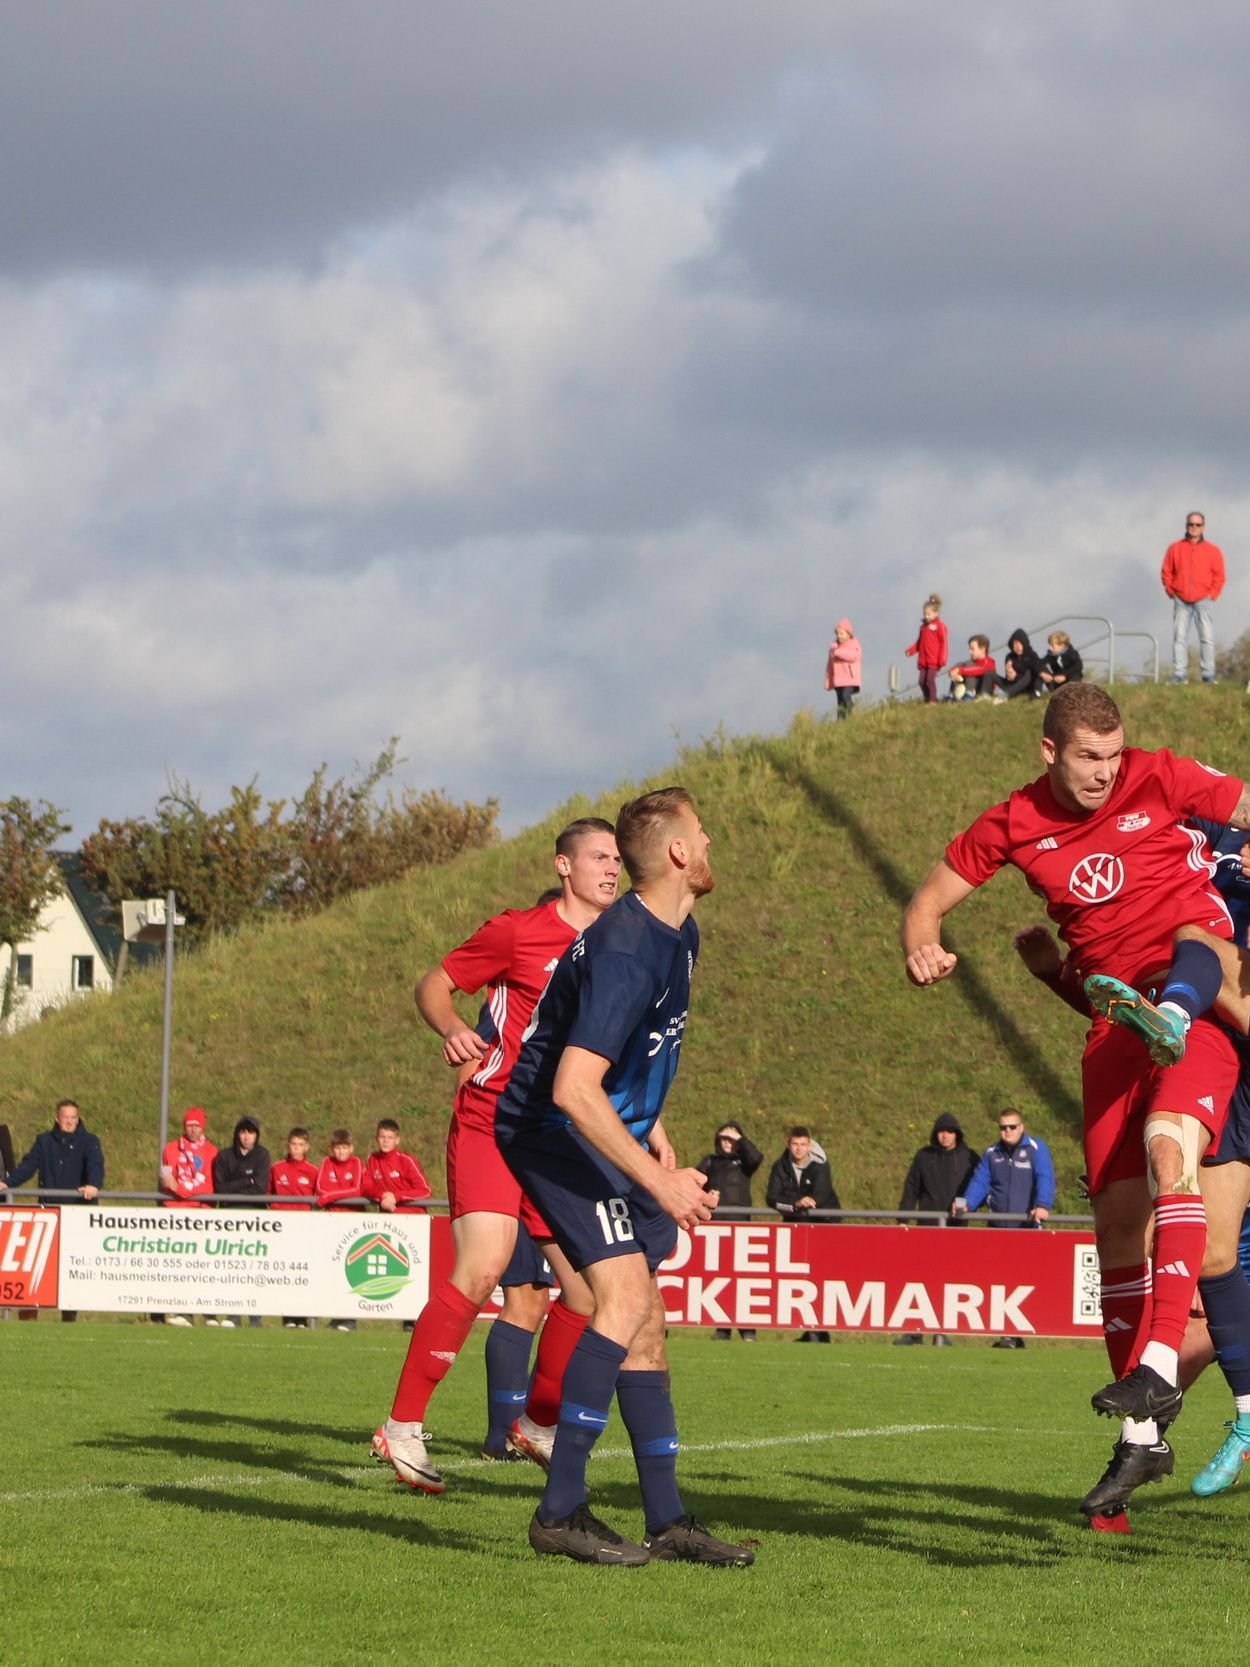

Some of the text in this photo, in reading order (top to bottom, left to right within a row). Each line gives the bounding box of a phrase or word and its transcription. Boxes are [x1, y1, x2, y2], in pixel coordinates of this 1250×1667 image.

[89, 1212, 282, 1233] Hausmeisterservice
[596, 1198, 634, 1245] 18
[102, 1235, 268, 1257] Christian Ulrich
[332, 1220, 422, 1265] Service für Haus und
[656, 1225, 811, 1274] OTEL
[70, 1255, 92, 1266] Tel.:
[95, 1256, 121, 1267] 0173
[130, 1257, 143, 1268] 66
[148, 1258, 160, 1268] 30
[163, 1258, 182, 1269] 555
[185, 1259, 210, 1270] oder
[214, 1260, 247, 1270] 01523
[257, 1261, 270, 1271] 78
[273, 1261, 286, 1272] 03
[289, 1262, 309, 1272] 444
[69, 1269, 309, 1287] Mail: hausmeisterservice-ulrich@web.de
[0, 1283, 25, 1300] 52
[117, 1296, 143, 1305] 17291
[147, 1296, 187, 1306] Prenzlau
[195, 1298, 212, 1306] Am
[214, 1298, 243, 1308] Strom
[246, 1299, 257, 1308] 10
[358, 1299, 394, 1313] Garten
[656, 1274, 1036, 1334] CKERMARK
